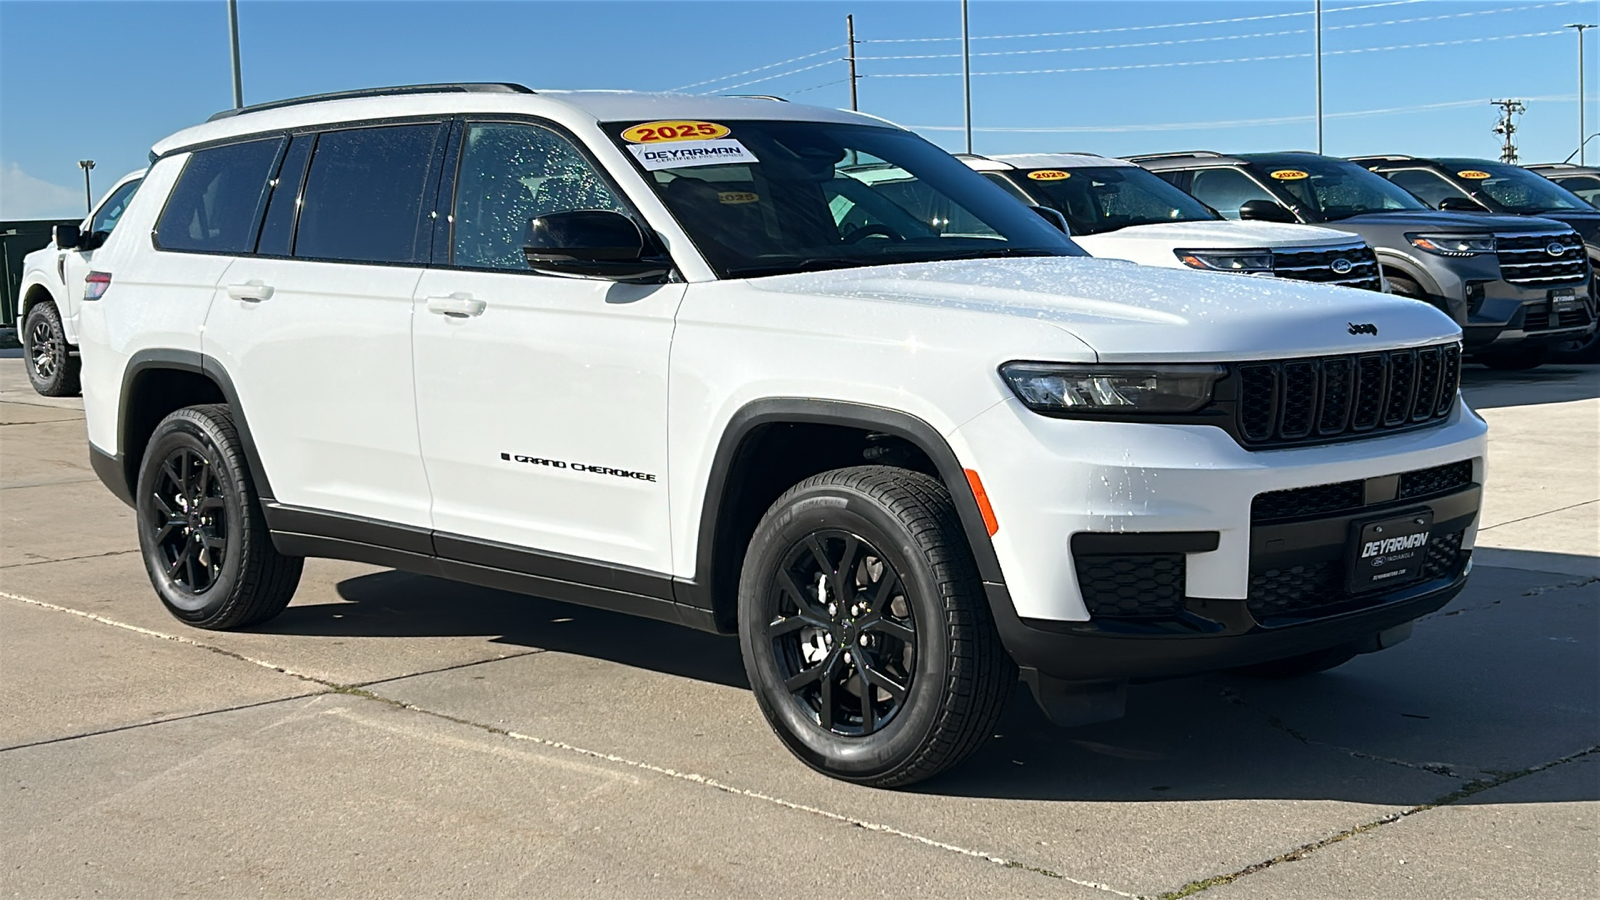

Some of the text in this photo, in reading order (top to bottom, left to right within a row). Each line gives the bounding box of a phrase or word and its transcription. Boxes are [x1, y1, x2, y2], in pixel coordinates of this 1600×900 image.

[636, 124, 717, 142] 2025
[644, 147, 741, 160] DEYARMAN
[655, 155, 697, 163] CERTIFIED
[1033, 171, 1066, 179] 2025
[1275, 171, 1304, 179] 2025
[1347, 321, 1378, 336] Jeep
[514, 454, 657, 482] GRAND CHEROKEE
[1361, 531, 1430, 558] DEYARMAN
